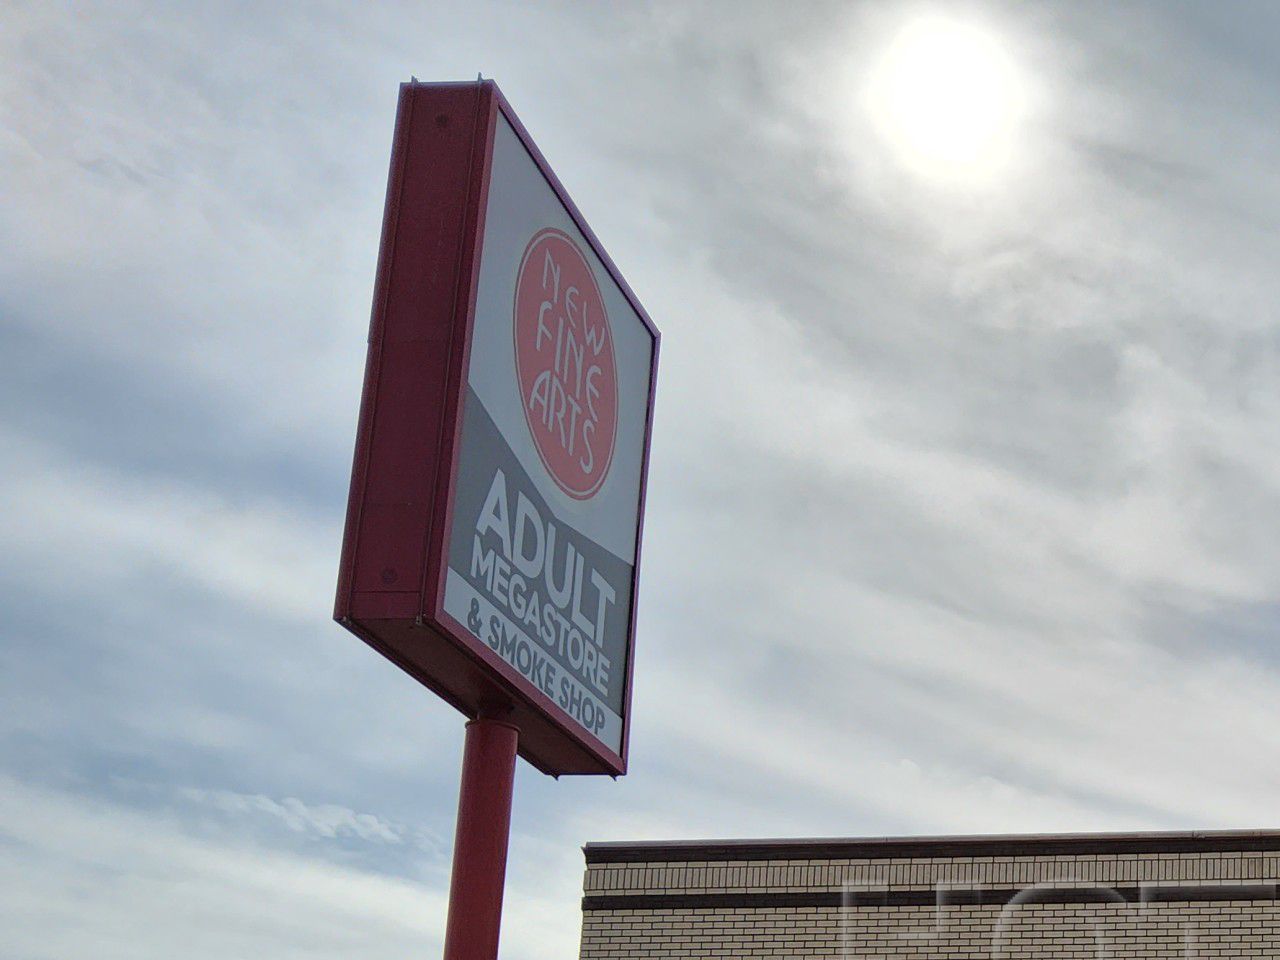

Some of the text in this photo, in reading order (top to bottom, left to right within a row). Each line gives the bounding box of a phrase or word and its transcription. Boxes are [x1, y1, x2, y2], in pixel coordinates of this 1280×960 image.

[536, 301, 602, 423] FINE
[542, 248, 605, 356] NEW
[529, 370, 596, 474] ARTS
[470, 533, 611, 698] MEGASTORE
[476, 467, 616, 649] ADULT
[467, 597, 606, 736] & SMOKE SHOP
